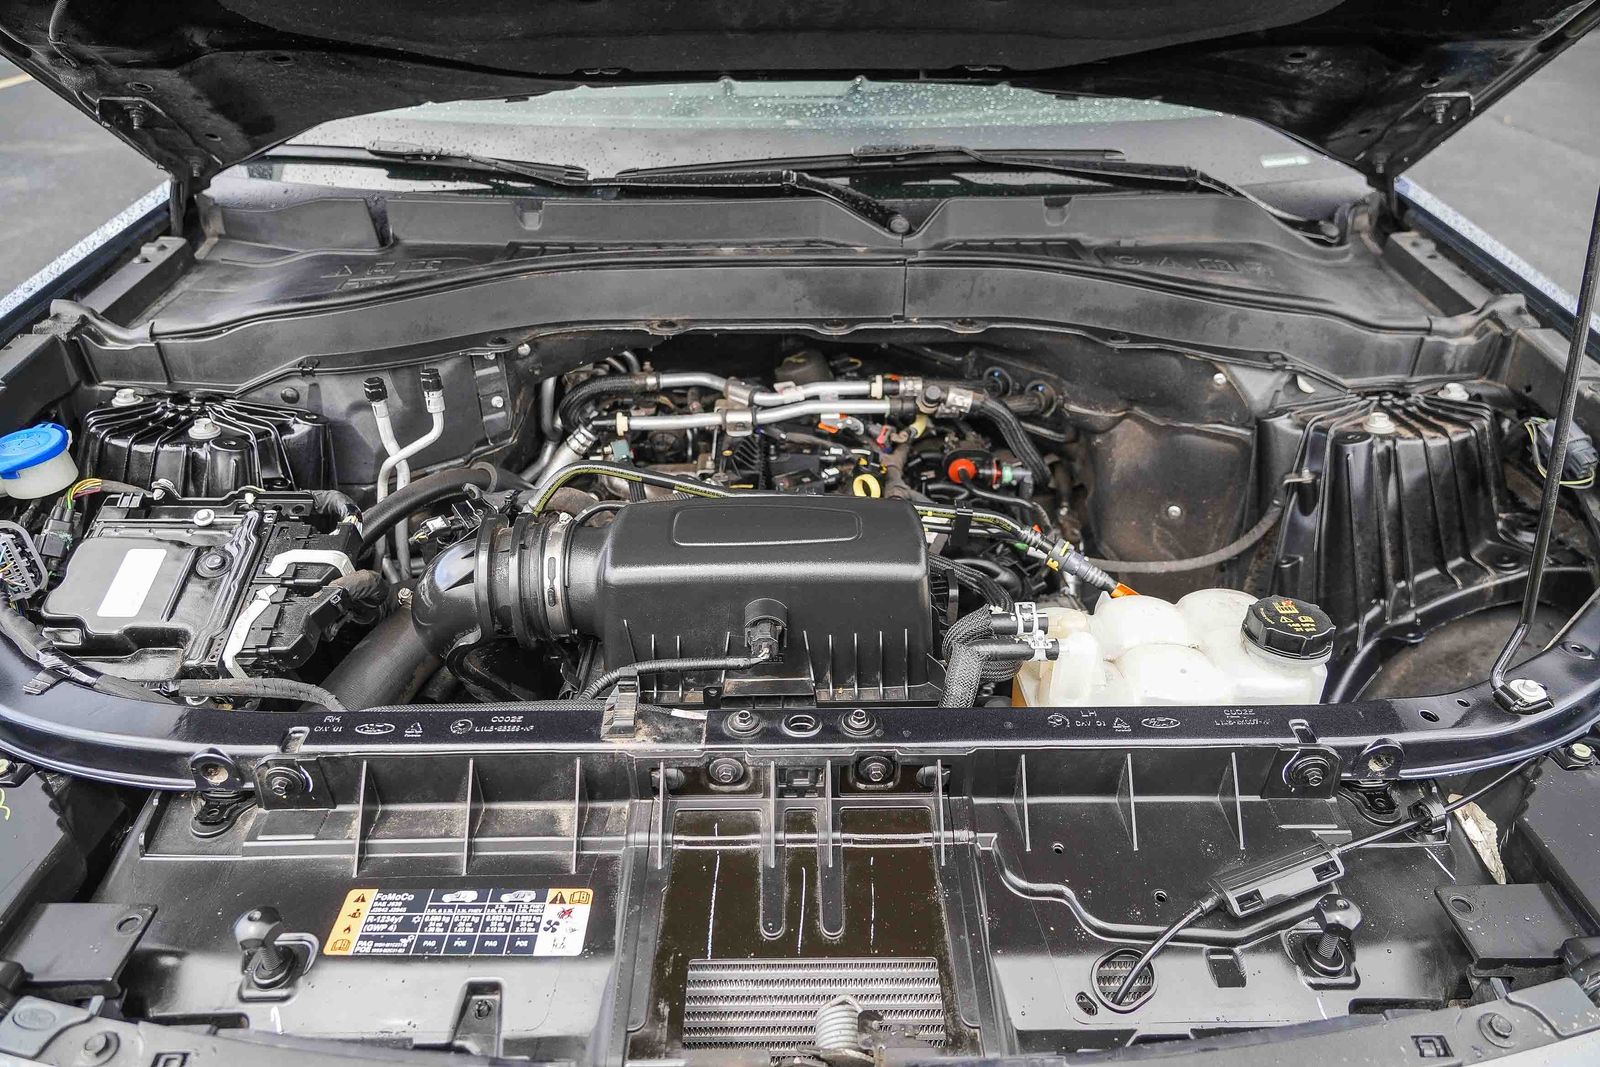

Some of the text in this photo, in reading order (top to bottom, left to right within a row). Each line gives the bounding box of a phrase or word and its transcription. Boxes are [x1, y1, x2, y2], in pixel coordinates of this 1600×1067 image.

[376, 892, 414, 900] FoMoCo
[366, 916, 404, 924] R-1234yf
[363, 924, 398, 932] (GWP 4)
